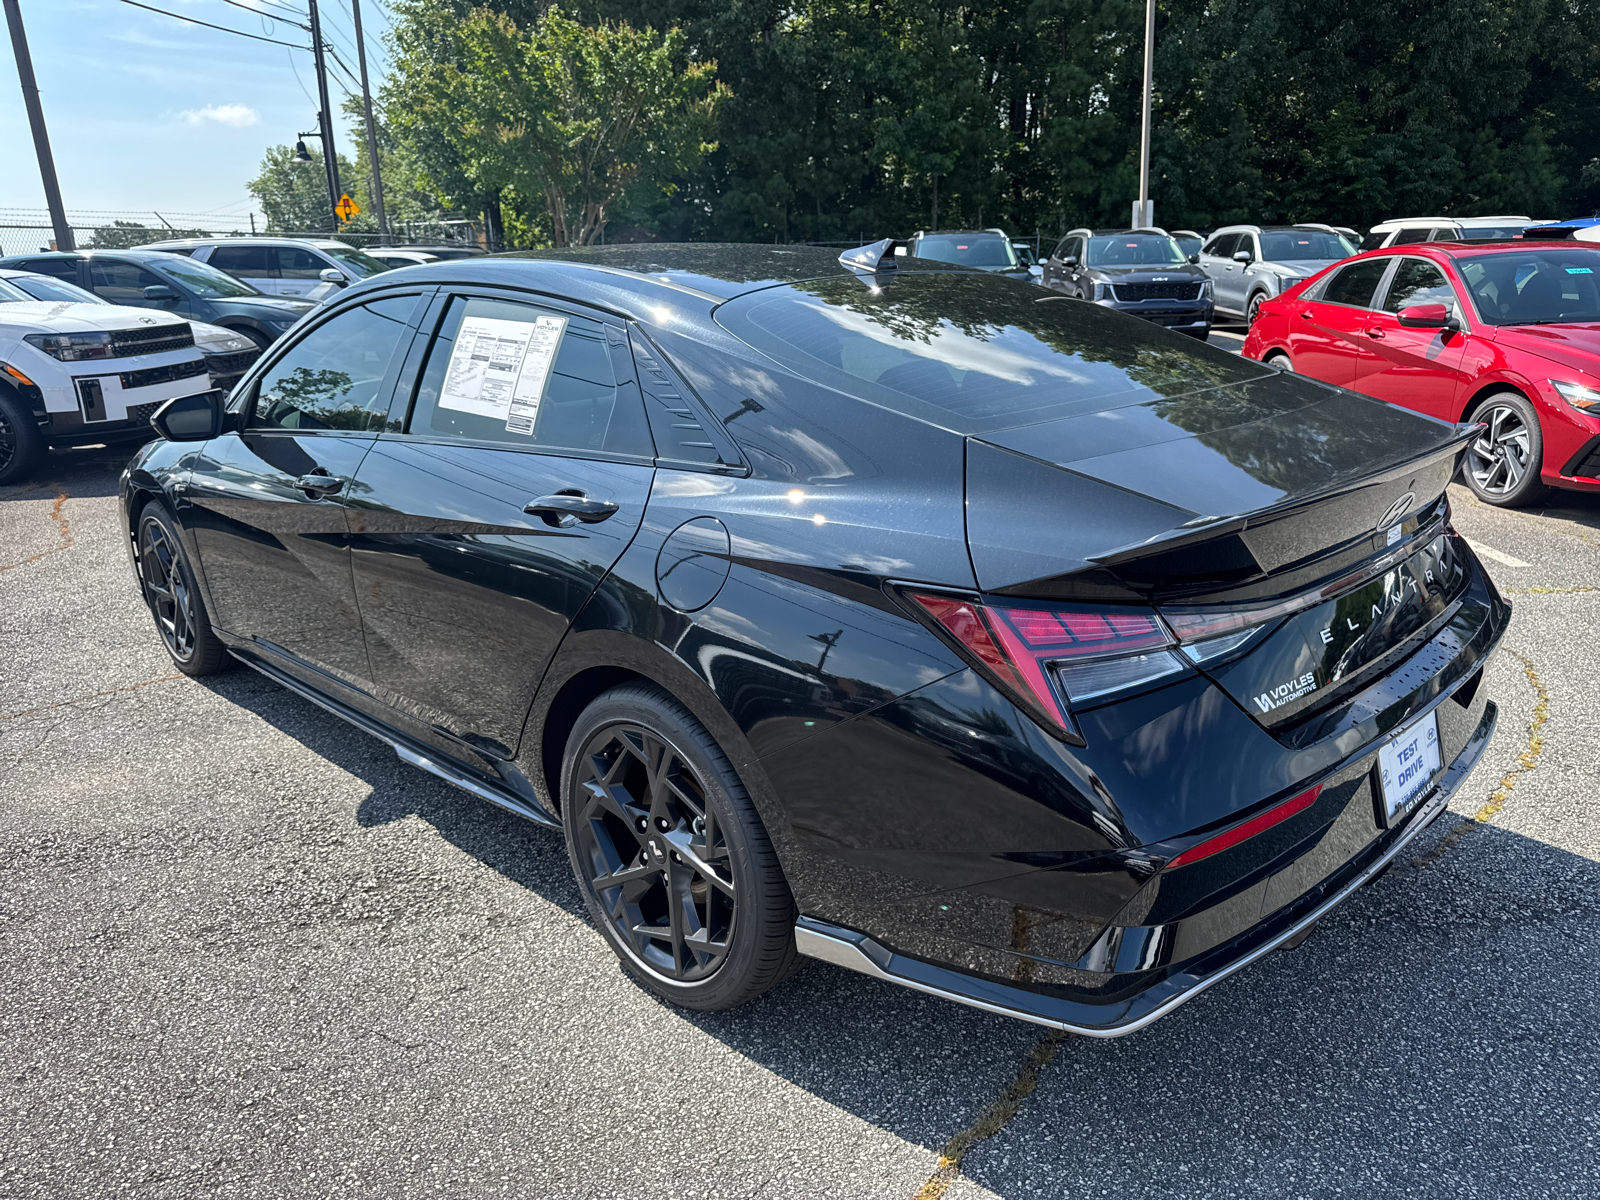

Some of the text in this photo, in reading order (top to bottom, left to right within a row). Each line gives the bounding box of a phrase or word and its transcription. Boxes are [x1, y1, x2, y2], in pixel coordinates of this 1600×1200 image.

[1319, 560, 1447, 644] ELANTRA
[1270, 671, 1315, 699] VOYLES
[1276, 682, 1317, 707] AUTOMOTIVE
[1397, 738, 1418, 765] TEST
[1398, 755, 1424, 787] DRIVE
[1405, 781, 1434, 813] ED VOYLES
